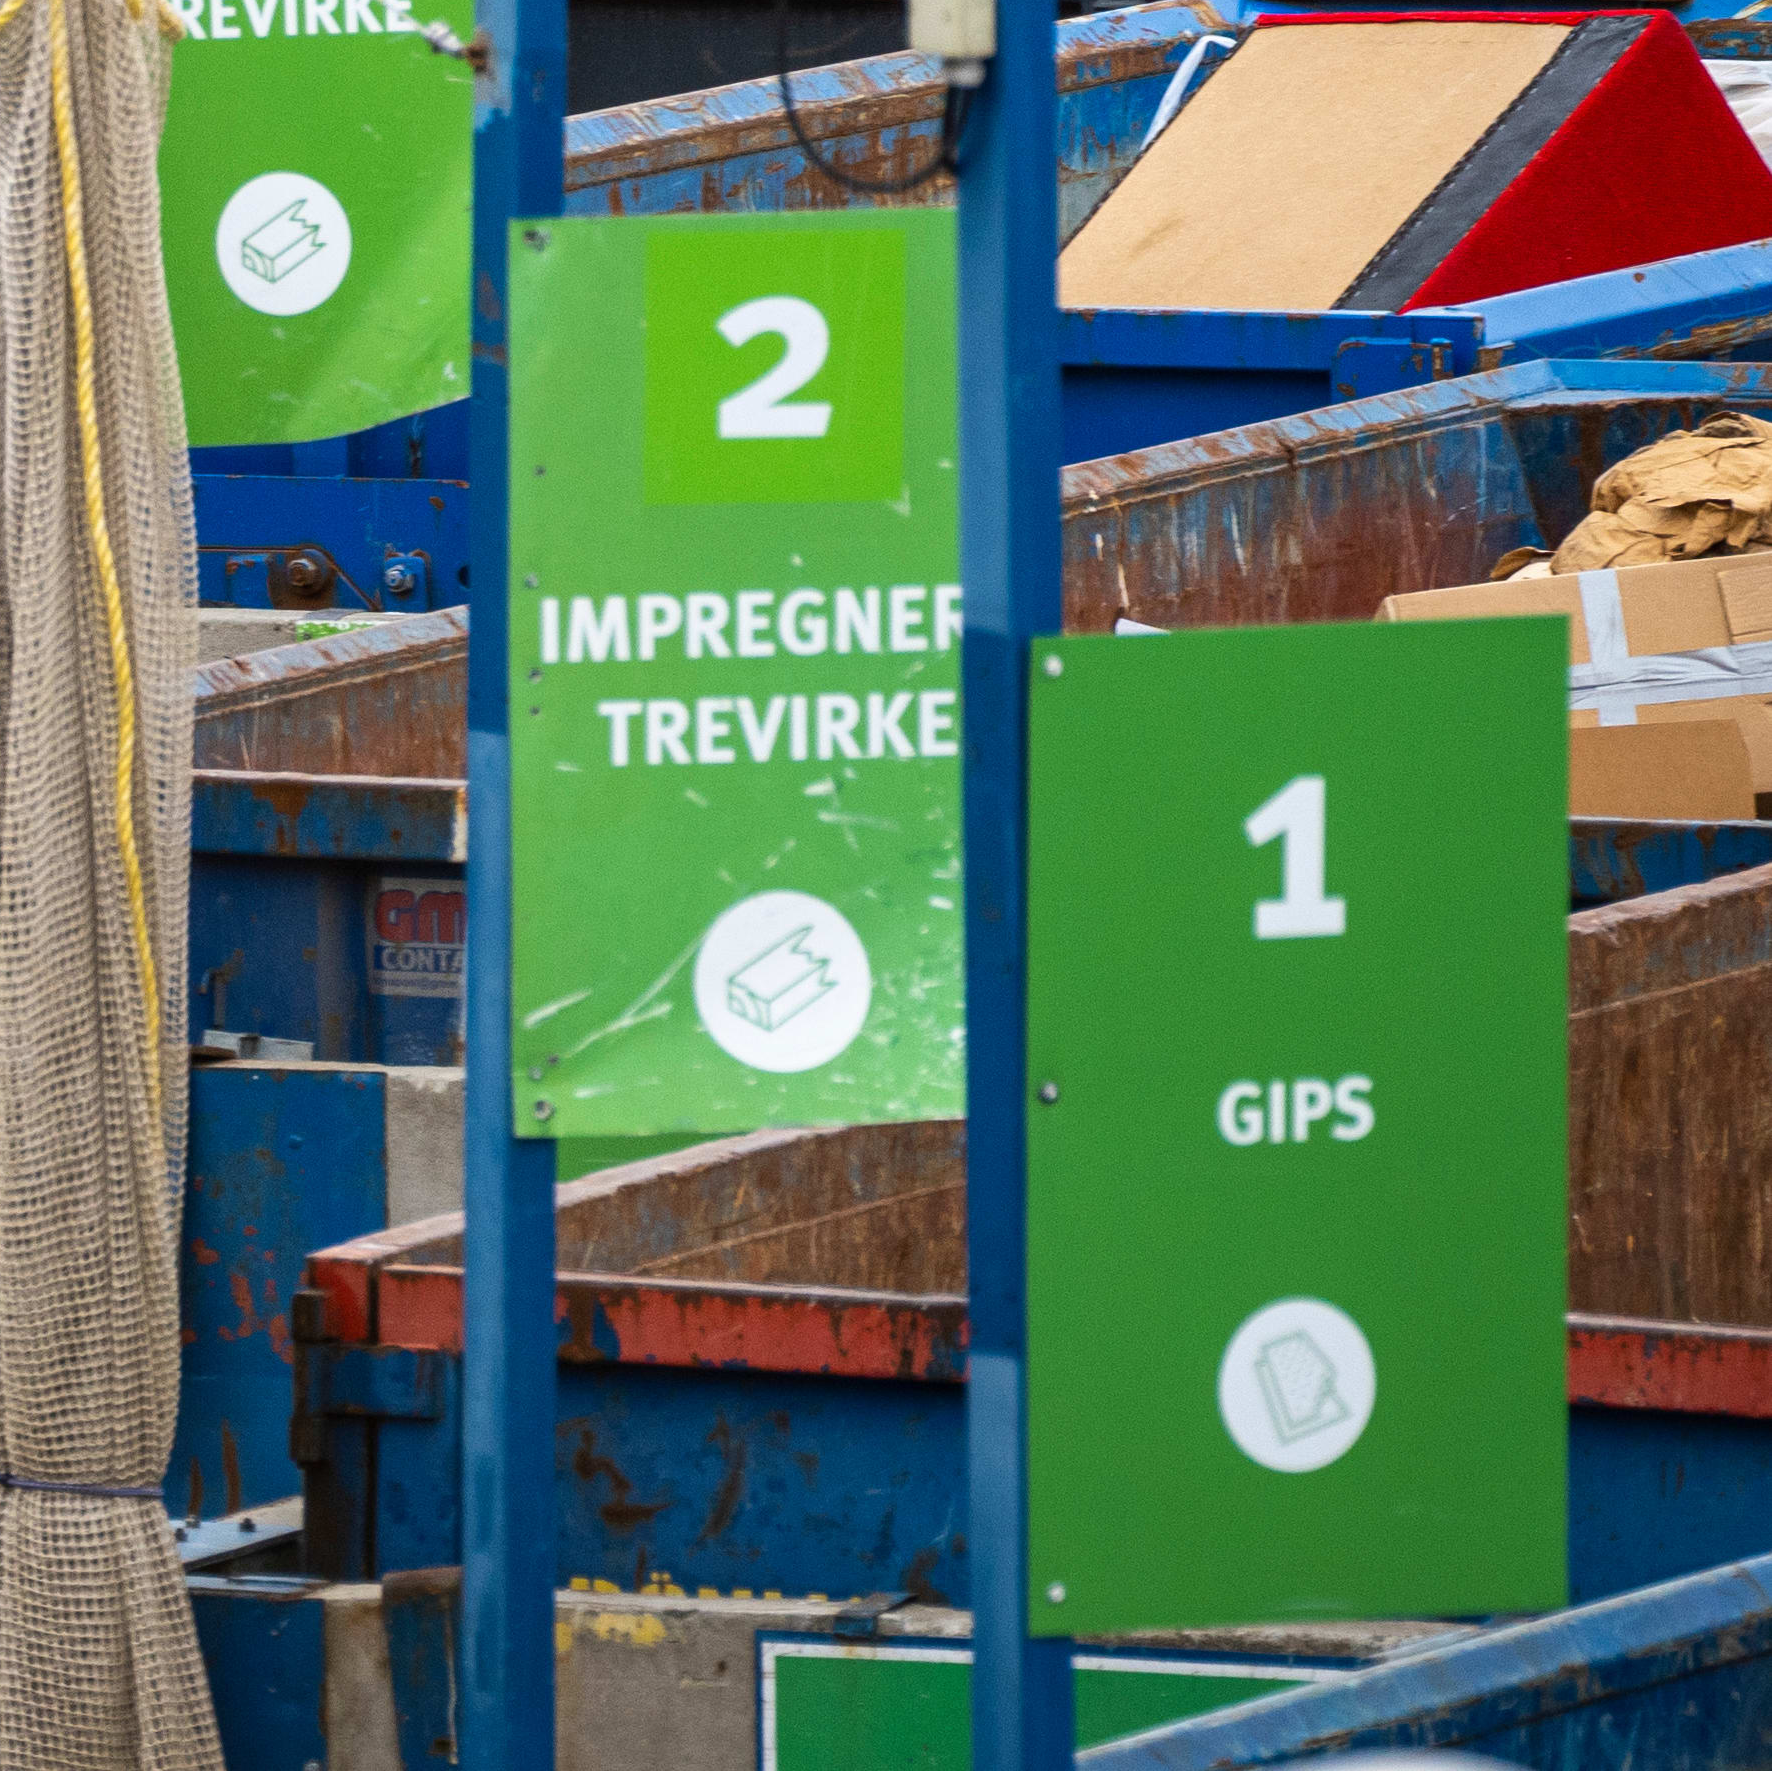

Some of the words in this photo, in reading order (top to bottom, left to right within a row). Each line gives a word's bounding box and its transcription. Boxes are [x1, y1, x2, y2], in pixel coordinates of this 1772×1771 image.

[716, 296, 833, 440] 2
[596, 689, 958, 768] TREVIRKE
[1244, 775, 1346, 940] 1
[1216, 1074, 1375, 1146] GIPS
